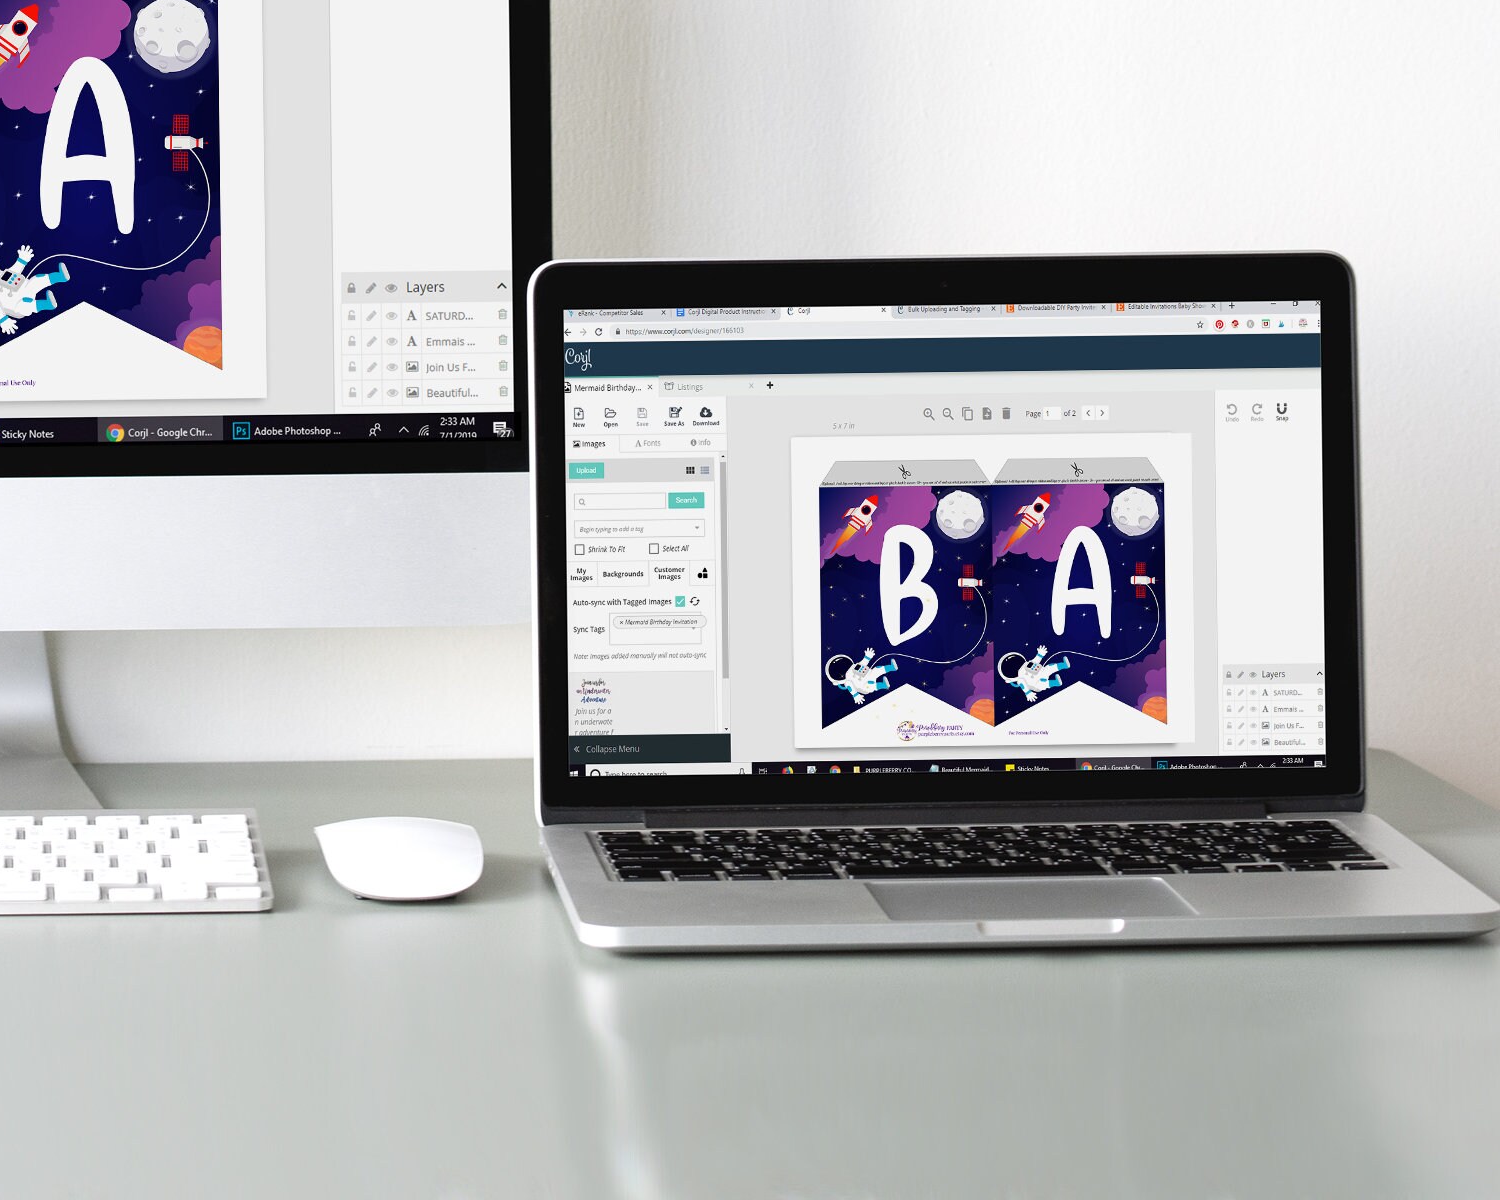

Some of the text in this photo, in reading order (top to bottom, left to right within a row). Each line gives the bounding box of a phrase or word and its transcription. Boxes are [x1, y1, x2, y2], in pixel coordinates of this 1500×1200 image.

[40, 56, 136, 235] A
[406, 282, 445, 296] Layers
[426, 337, 465, 347] Emmais
[426, 363, 444, 374] Join
[447, 363, 460, 372] Us
[440, 417, 475, 426] 2:33 AM
[1, 429, 54, 441] Sticky Notes
[128, 428, 148, 440] Corjl
[157, 428, 188, 439] Google
[254, 426, 331, 437] Adobe Photoshop
[879, 524, 1112, 647] B A
